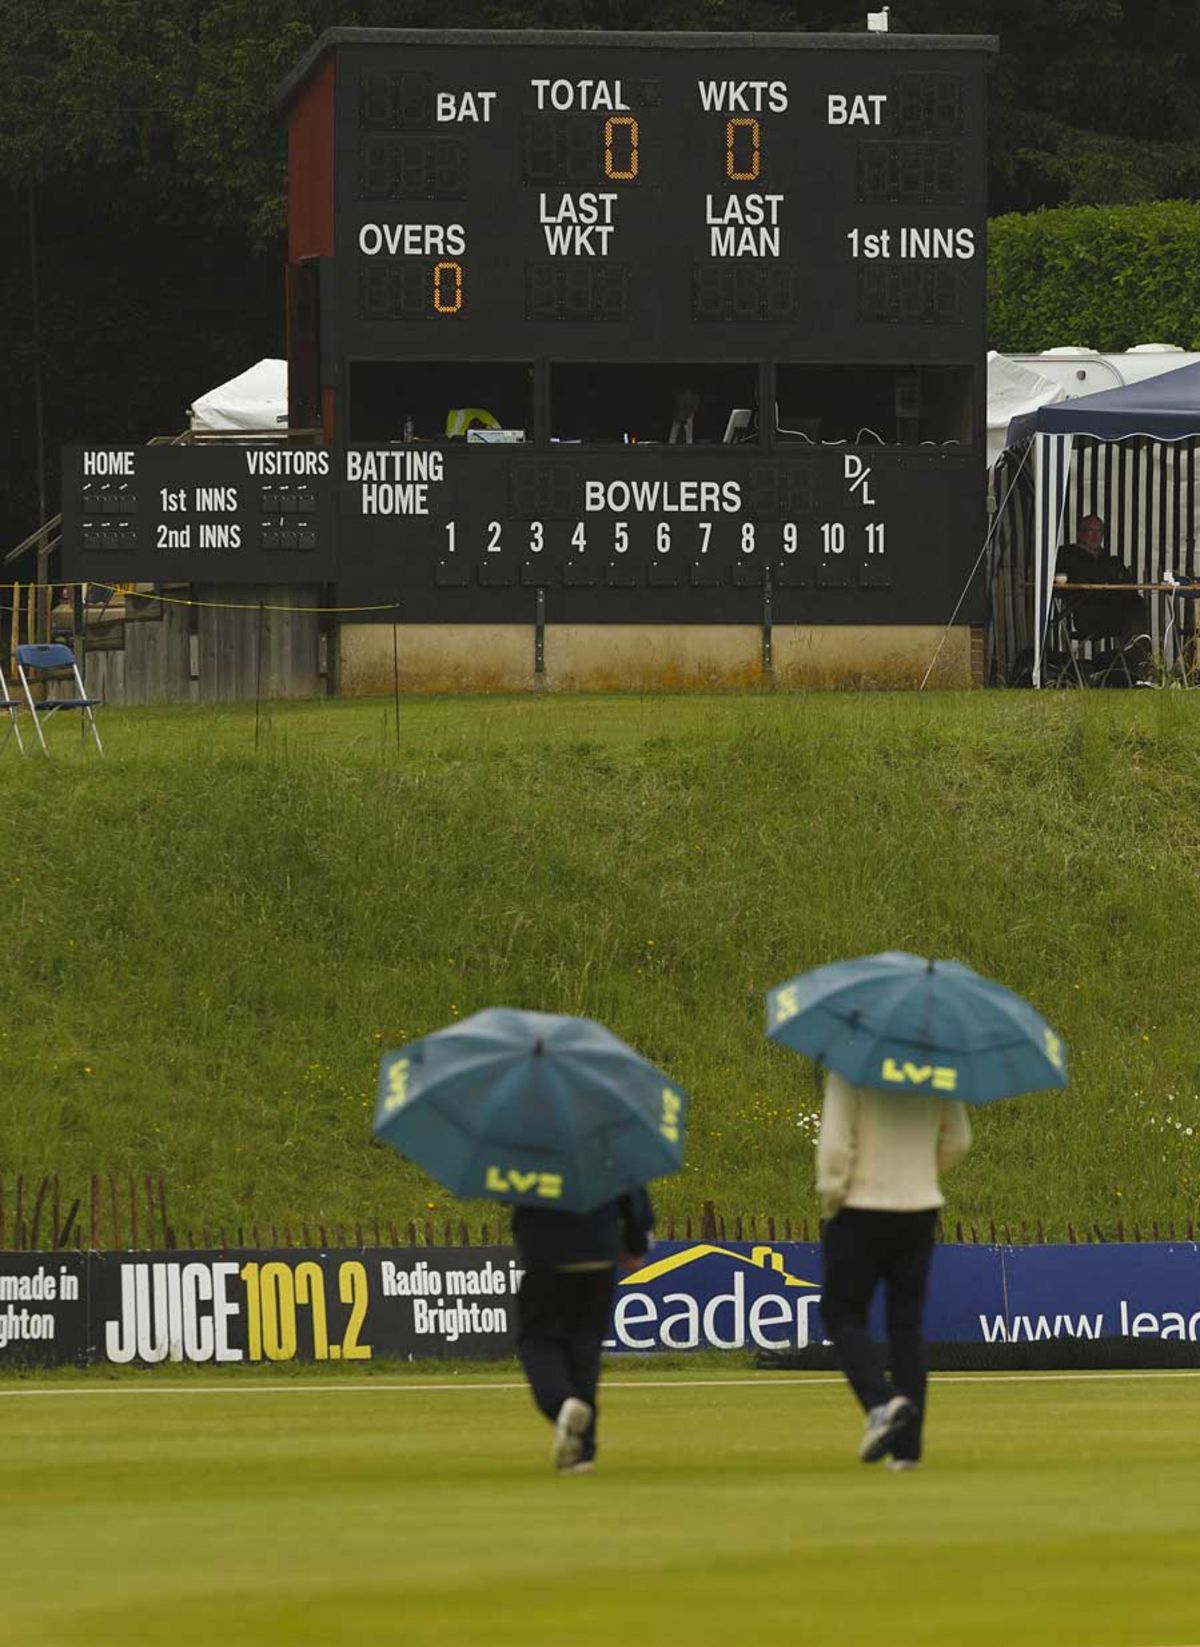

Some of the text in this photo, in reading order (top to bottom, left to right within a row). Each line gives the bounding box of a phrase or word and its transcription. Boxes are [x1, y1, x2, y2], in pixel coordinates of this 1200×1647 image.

[437, 92, 496, 122] BAT
[531, 79, 630, 110] TOTAL
[698, 81, 788, 112] WKTS
[828, 95, 887, 125] BAT
[605, 116, 639, 180] 0
[726, 118, 760, 181] 0
[540, 193, 617, 224] LAST
[706, 194, 784, 225] LAST
[359, 224, 466, 256] OVERS
[544, 225, 614, 256] WKT
[710, 227, 780, 257] MAN
[847, 228, 975, 259] 1st INNS
[433, 262, 462, 313] 0
[84, 451, 135, 475] HOME
[246, 451, 329, 475] VISITORS
[347, 451, 444, 481] BATTING
[160, 487, 238, 512] 1st INNS
[362, 484, 429, 515] HOME
[585, 481, 742, 512] BOWLERS
[157, 524, 241, 548] 2nd INNS
[445, 521, 885, 553] 1 2 3 4 5 6 7 8 9 10 11
[0, 1265, 79, 1301] made in
[381, 1261, 442, 1296] Radio
[446, 1261, 506, 1296] made
[413, 1298, 507, 1342] Brighton
[602, 1271, 834, 1349] eader
